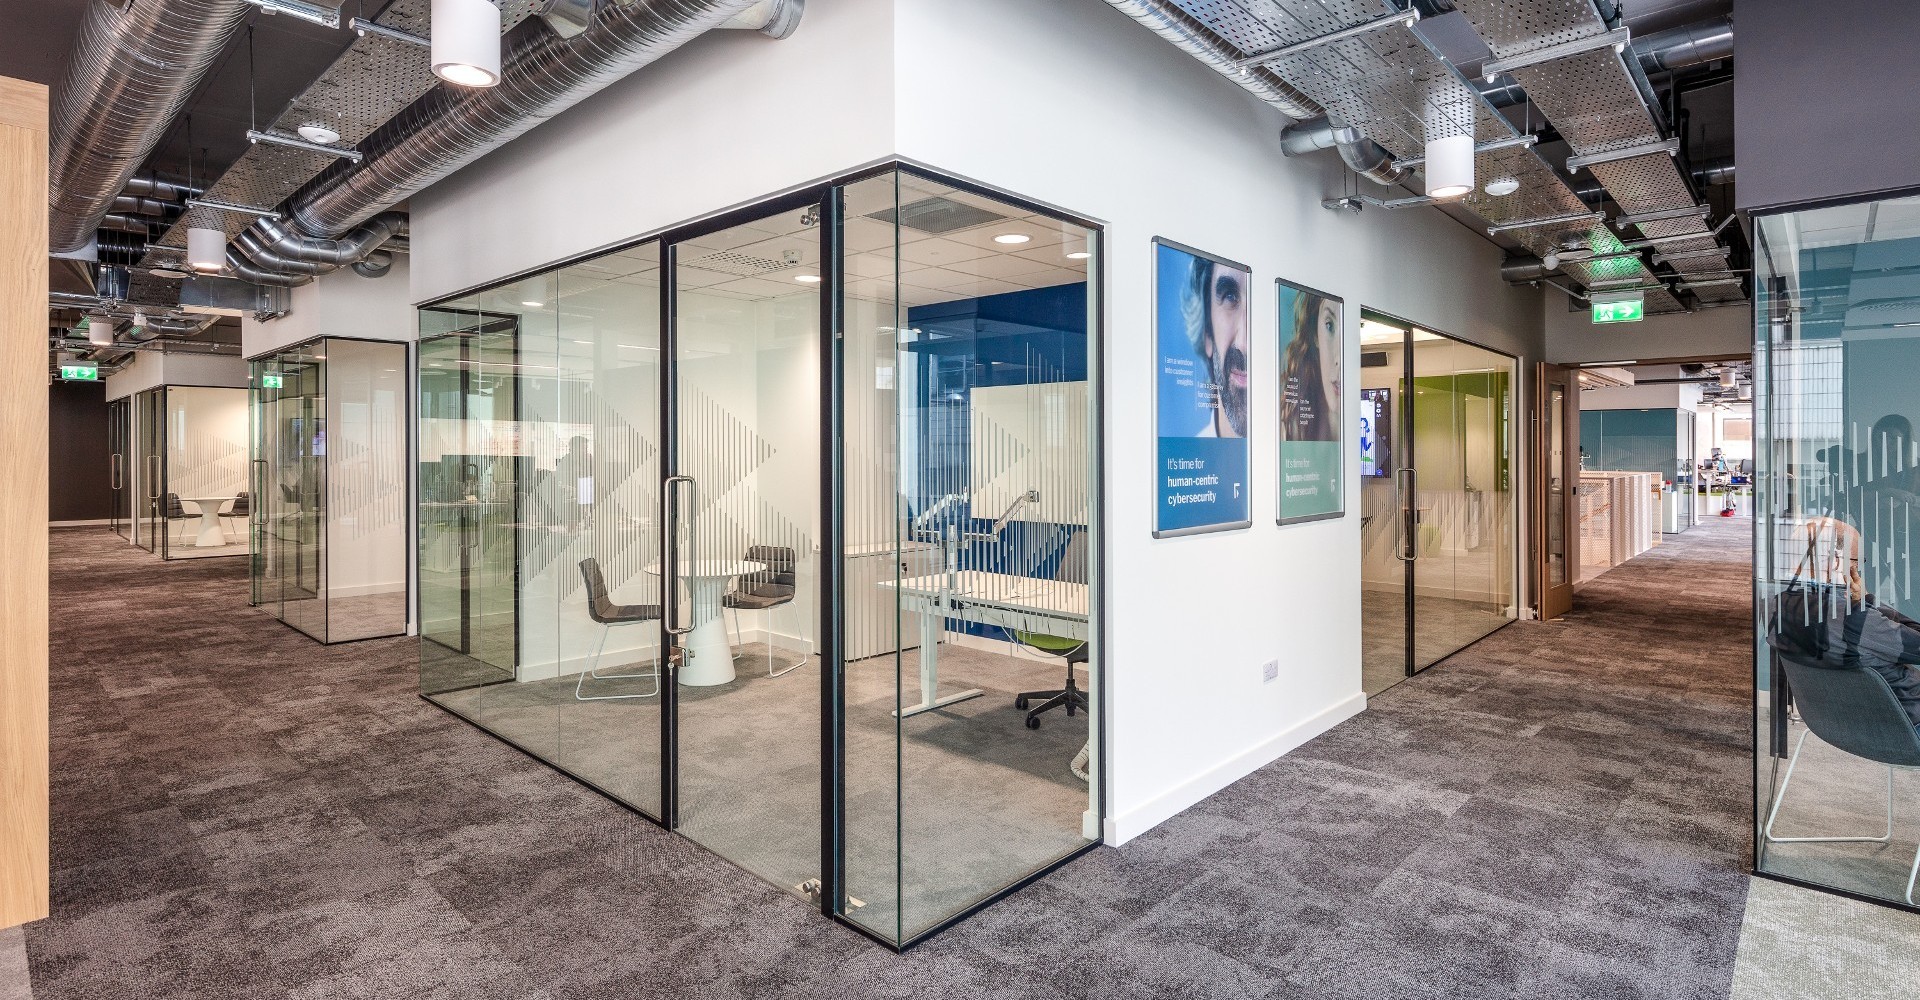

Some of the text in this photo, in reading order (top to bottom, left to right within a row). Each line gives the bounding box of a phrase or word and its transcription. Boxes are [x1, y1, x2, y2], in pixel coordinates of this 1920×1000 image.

[1173, 368, 1194, 376] customer
[1176, 378, 1194, 386] insights
[1167, 457, 1205, 470] It's time for
[1167, 473, 1219, 488] human-centric
[1285, 472, 1320, 483] human-centric
[1167, 490, 1217, 507] cybersecurity
[1285, 485, 1318, 499] cybersecurity
